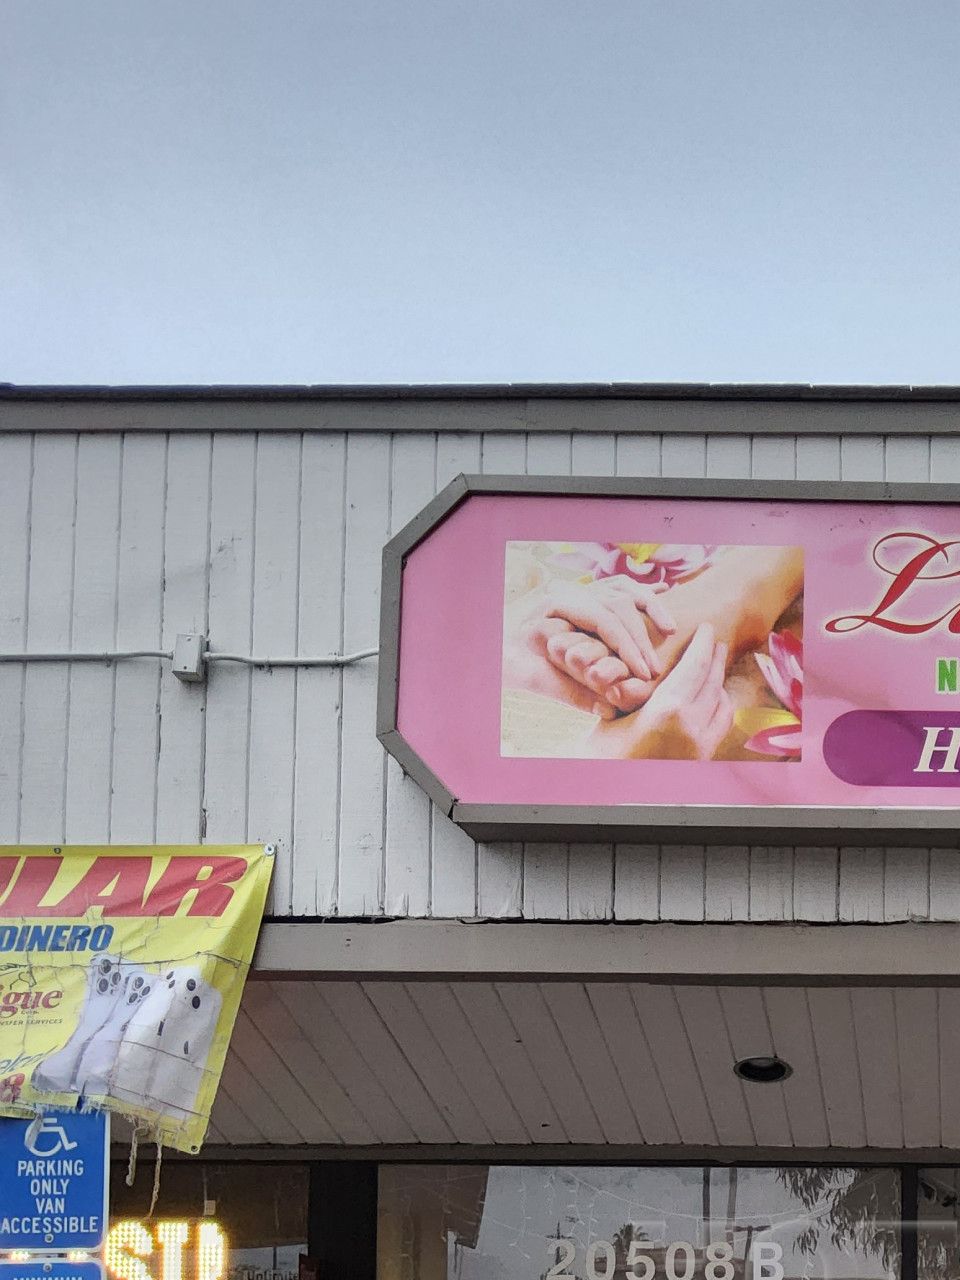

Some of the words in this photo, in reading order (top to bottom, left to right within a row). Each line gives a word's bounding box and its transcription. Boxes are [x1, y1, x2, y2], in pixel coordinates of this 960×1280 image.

[17, 1160, 84, 1177] PARKING
[30, 1179, 70, 1196] ONLY
[36, 1198, 65, 1214] VAN
[1, 1216, 98, 1234] ACCESSIBLE
